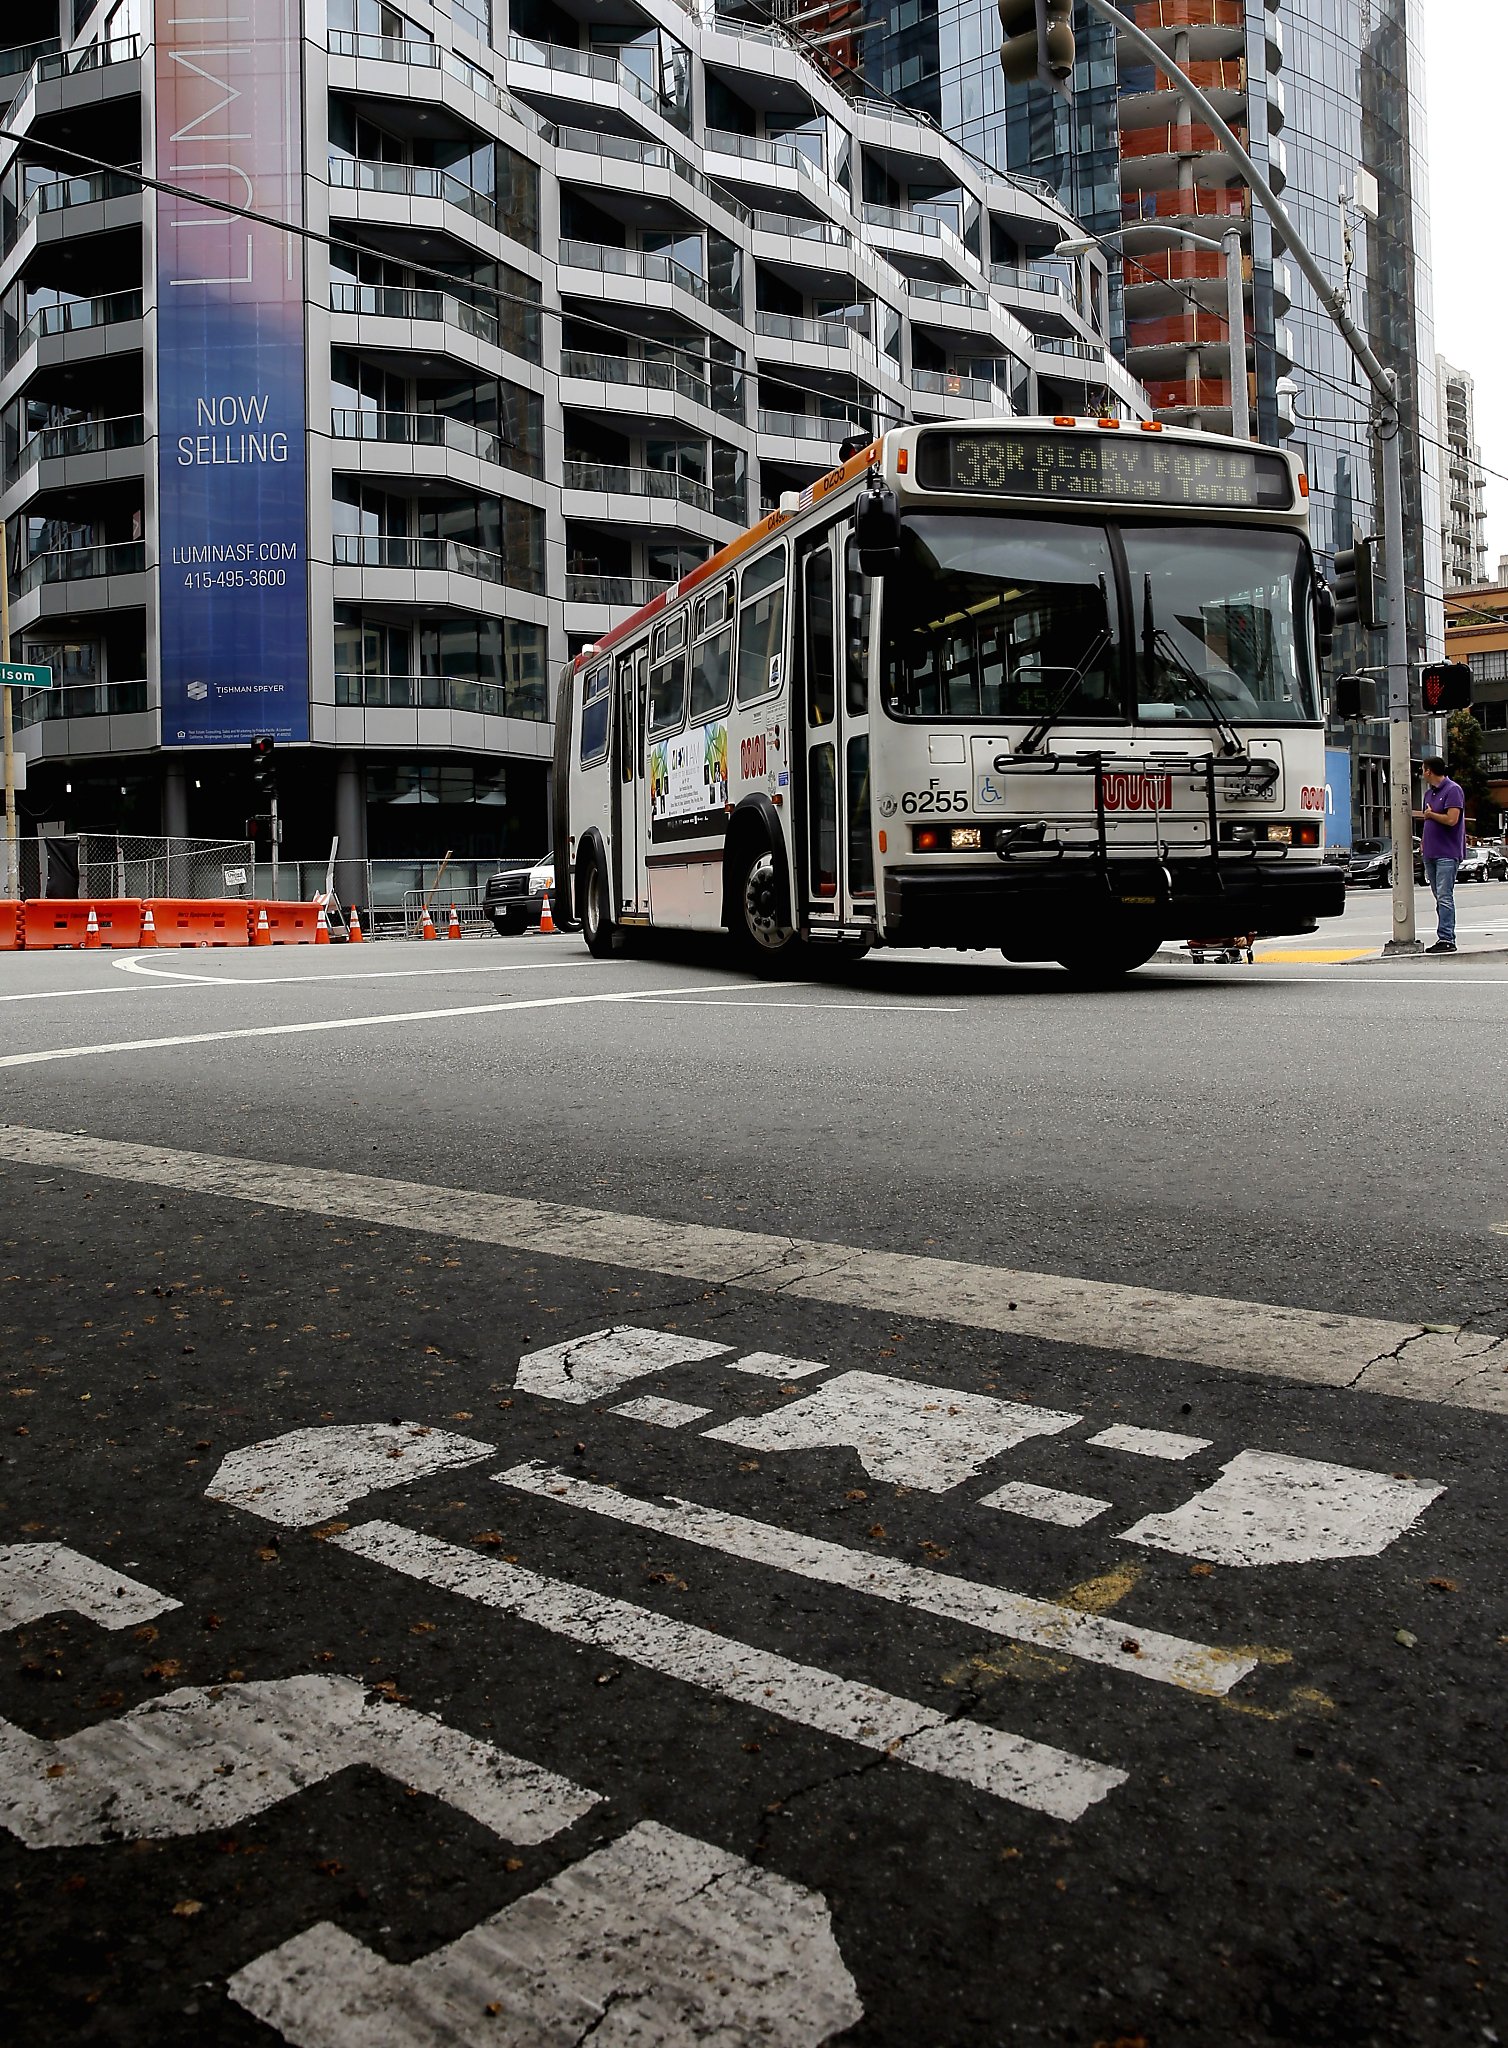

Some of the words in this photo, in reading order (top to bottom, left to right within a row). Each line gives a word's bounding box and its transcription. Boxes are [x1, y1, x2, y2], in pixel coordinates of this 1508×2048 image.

[197, 395, 269, 427] NOW
[177, 432, 288, 466] SELLING
[956, 440, 1024, 488] 38R
[1036, 444, 1139, 473] GEARY
[1153, 452, 1247, 480] RAPID
[1032, 466, 1161, 498] Transbay
[172, 542, 297, 565] LUMINASF.COM
[184, 569, 287, 589] 415-495-3600
[0, 668, 36, 681] lsom
[216, 686, 252, 694] TISHMAN
[253, 684, 285, 692] SPEYER
[929, 778, 940, 790] F
[901, 790, 969, 814] 6255
